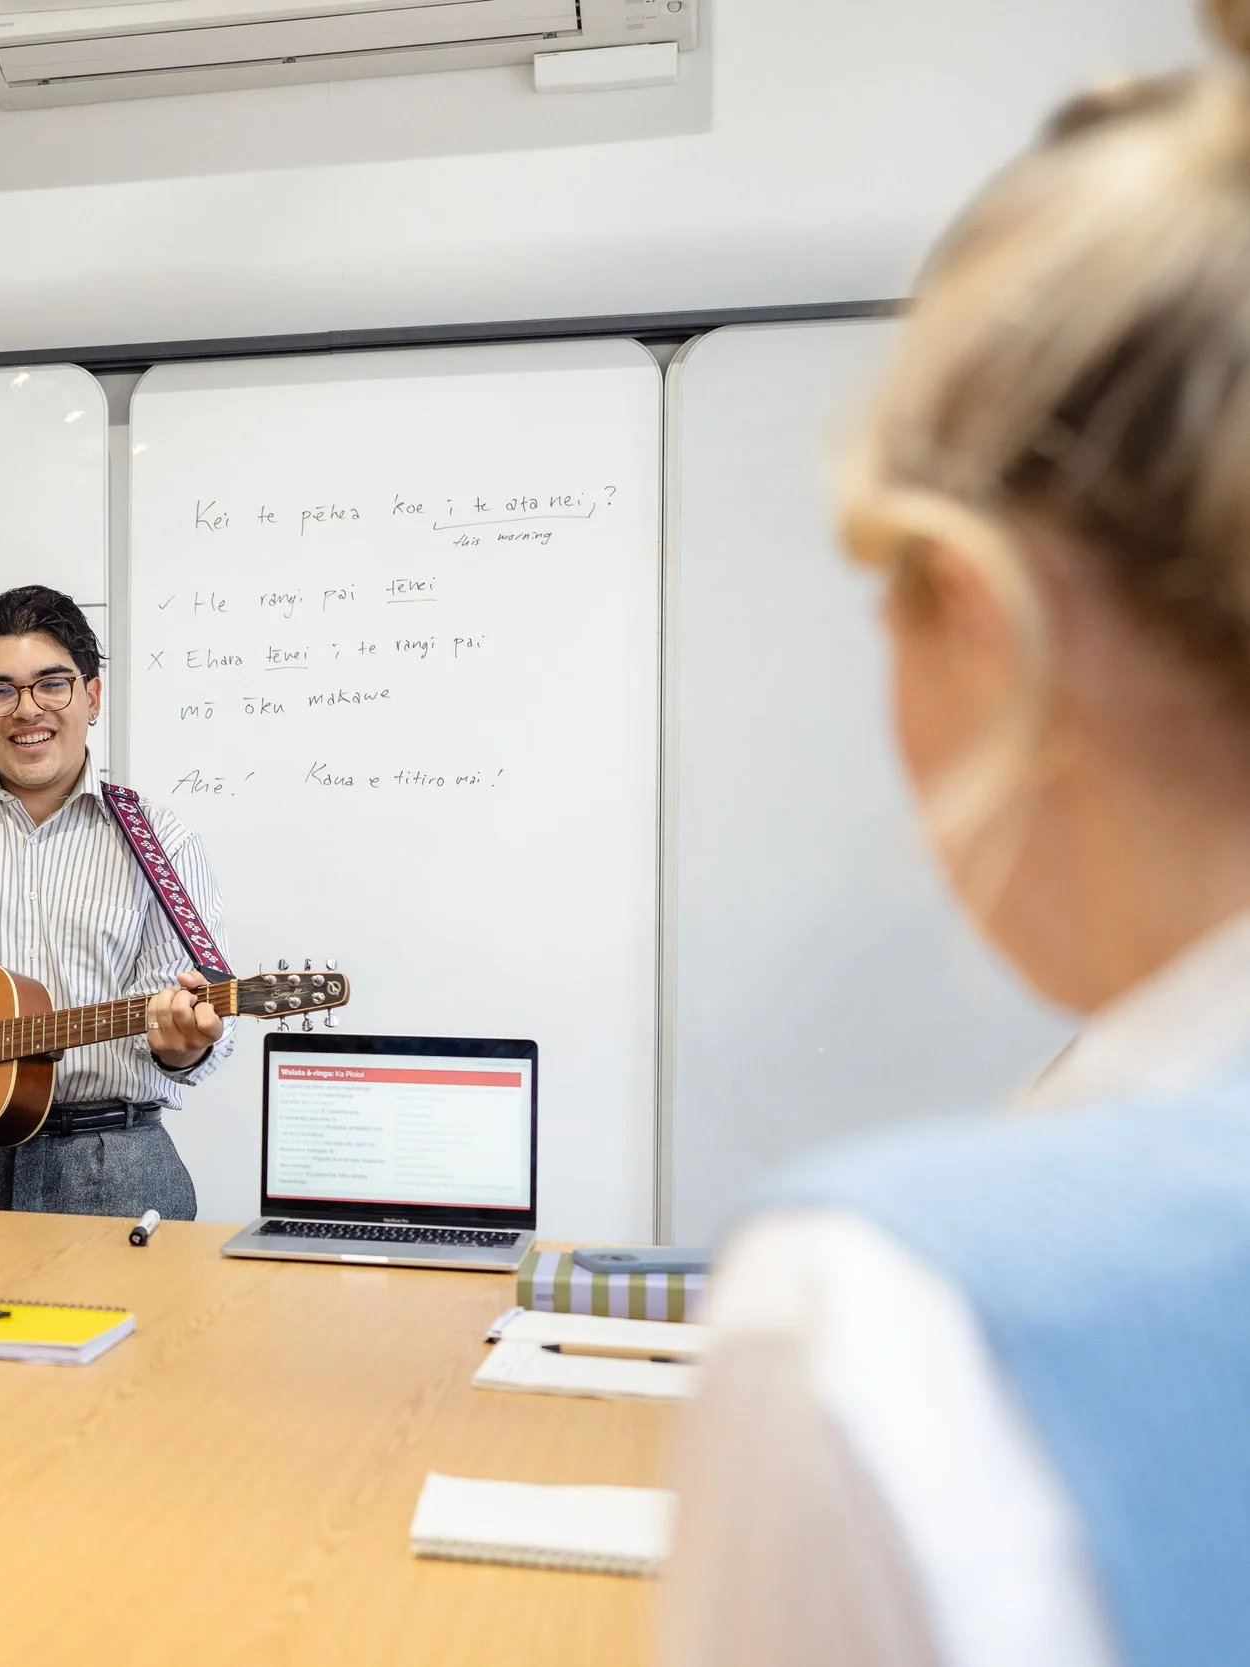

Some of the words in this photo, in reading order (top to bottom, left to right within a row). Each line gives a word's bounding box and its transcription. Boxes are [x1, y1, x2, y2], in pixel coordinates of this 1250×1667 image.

[196, 499, 230, 531] Kei
[257, 505, 278, 524] te
[301, 504, 360, 536] pēhea
[392, 494, 426, 515] koe
[474, 496, 492, 513] te
[505, 497, 539, 512] ata
[452, 533, 482, 548] this
[497, 530, 553, 546] morning
[260, 588, 304, 619] rangi
[323, 584, 356, 613] pai
[385, 576, 438, 596] tēnei
[186, 649, 243, 669] Ehara
[265, 646, 310, 664] tēnei
[358, 641, 377, 656] te
[395, 636, 436, 659] rangi
[453, 635, 486, 659] pai
[180, 701, 214, 720] mō
[243, 697, 285, 715] ōku
[308, 688, 391, 708] makawe
[305, 761, 355, 787] Kaua
[369, 775, 380, 789] e
[394, 770, 445, 789] titiro
